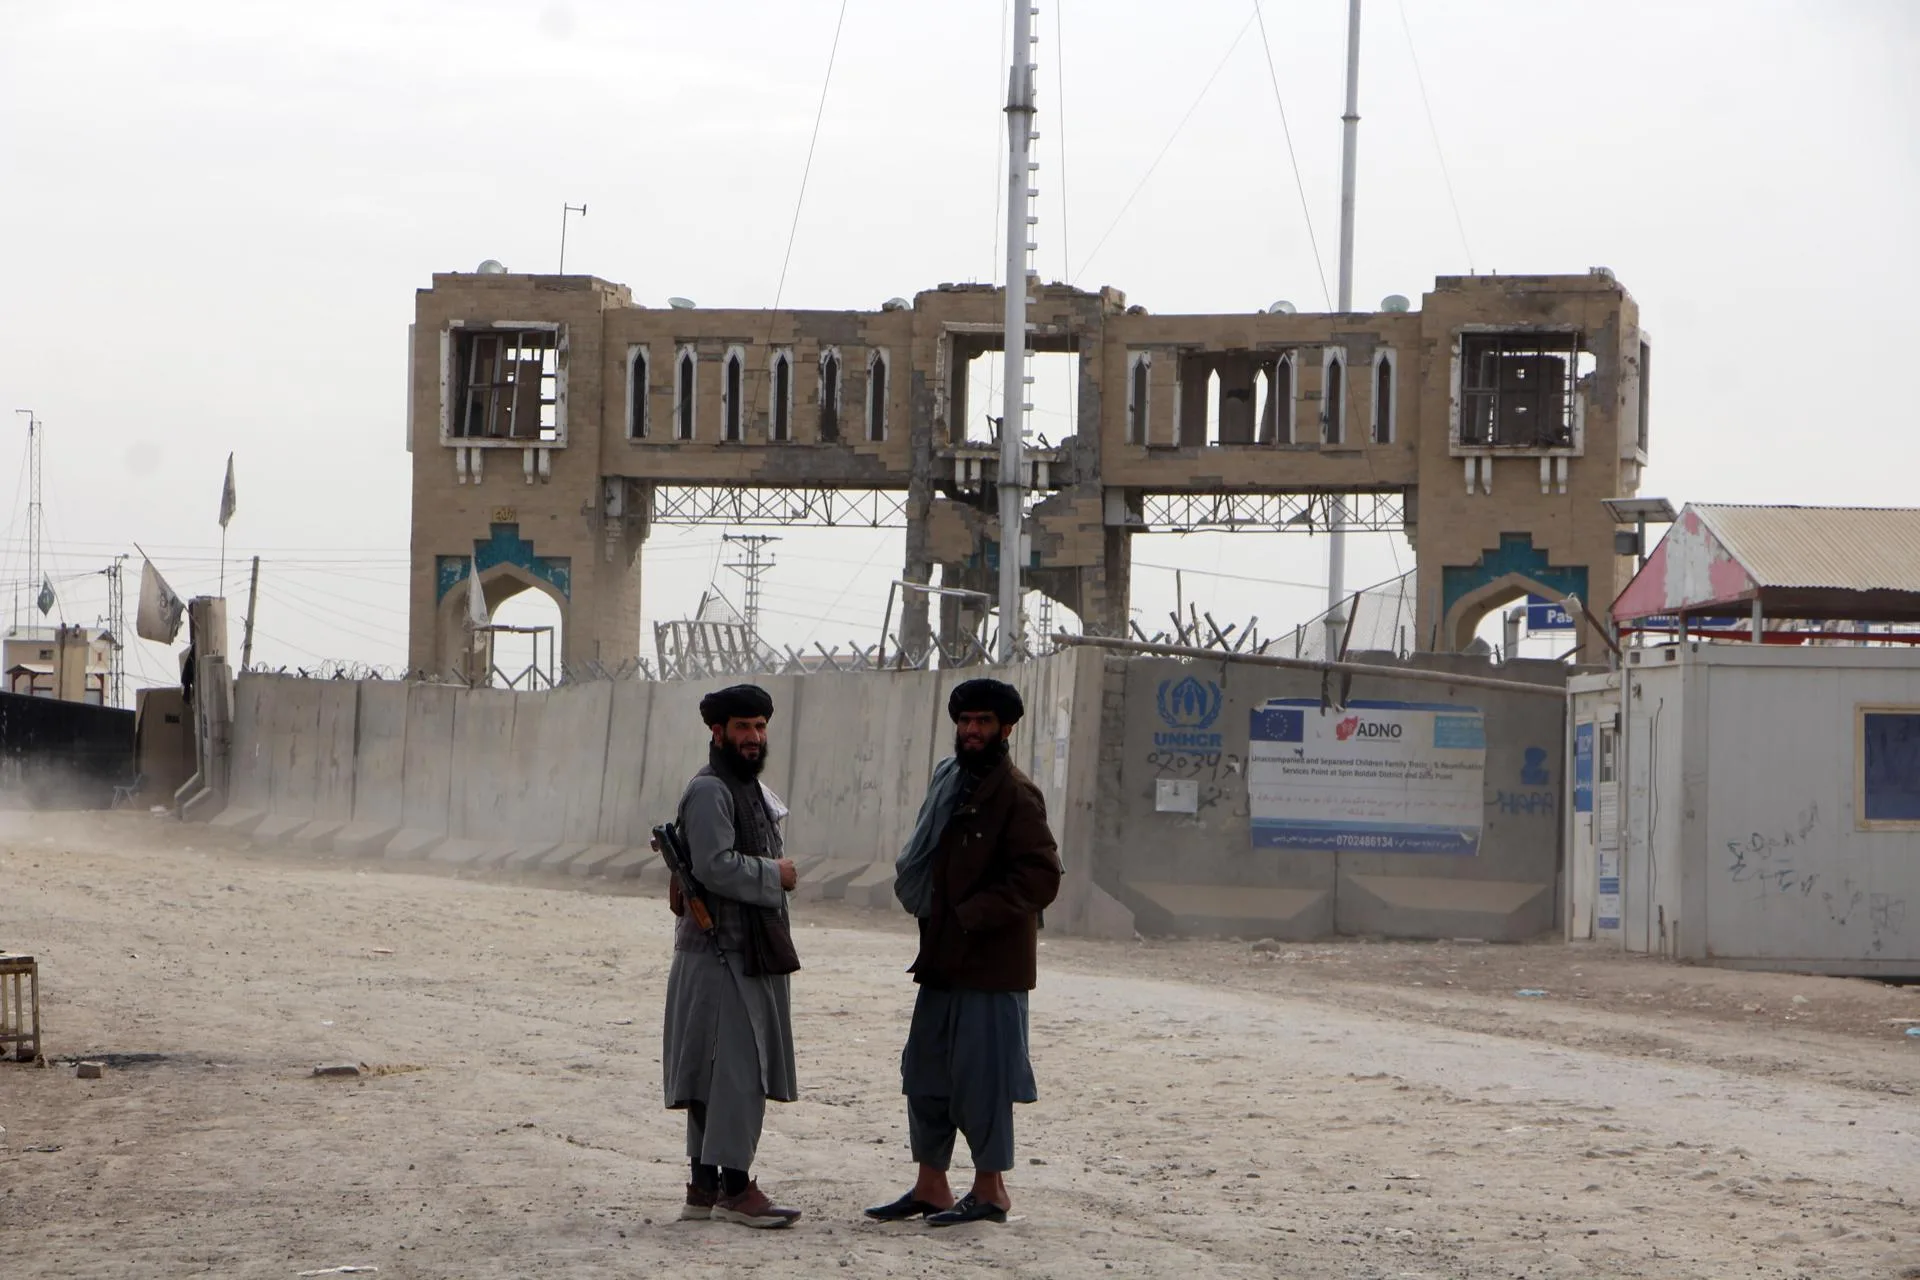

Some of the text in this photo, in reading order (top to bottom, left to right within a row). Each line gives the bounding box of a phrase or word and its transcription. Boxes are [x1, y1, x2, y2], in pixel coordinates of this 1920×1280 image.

[1357, 722, 1403, 738] ADNO
[1154, 732, 1222, 747] UNHCR
[1251, 755, 1304, 766] Unaccompanied
[1306, 757, 1319, 765] and
[1320, 758, 1354, 767] Separated
[1355, 758, 1384, 768] Children
[1385, 759, 1407, 770] Family
[1282, 767, 1309, 776] Services
[1311, 767, 1328, 777] Point
[1329, 768, 1338, 777] at
[1338, 768, 1353, 779] Spin
